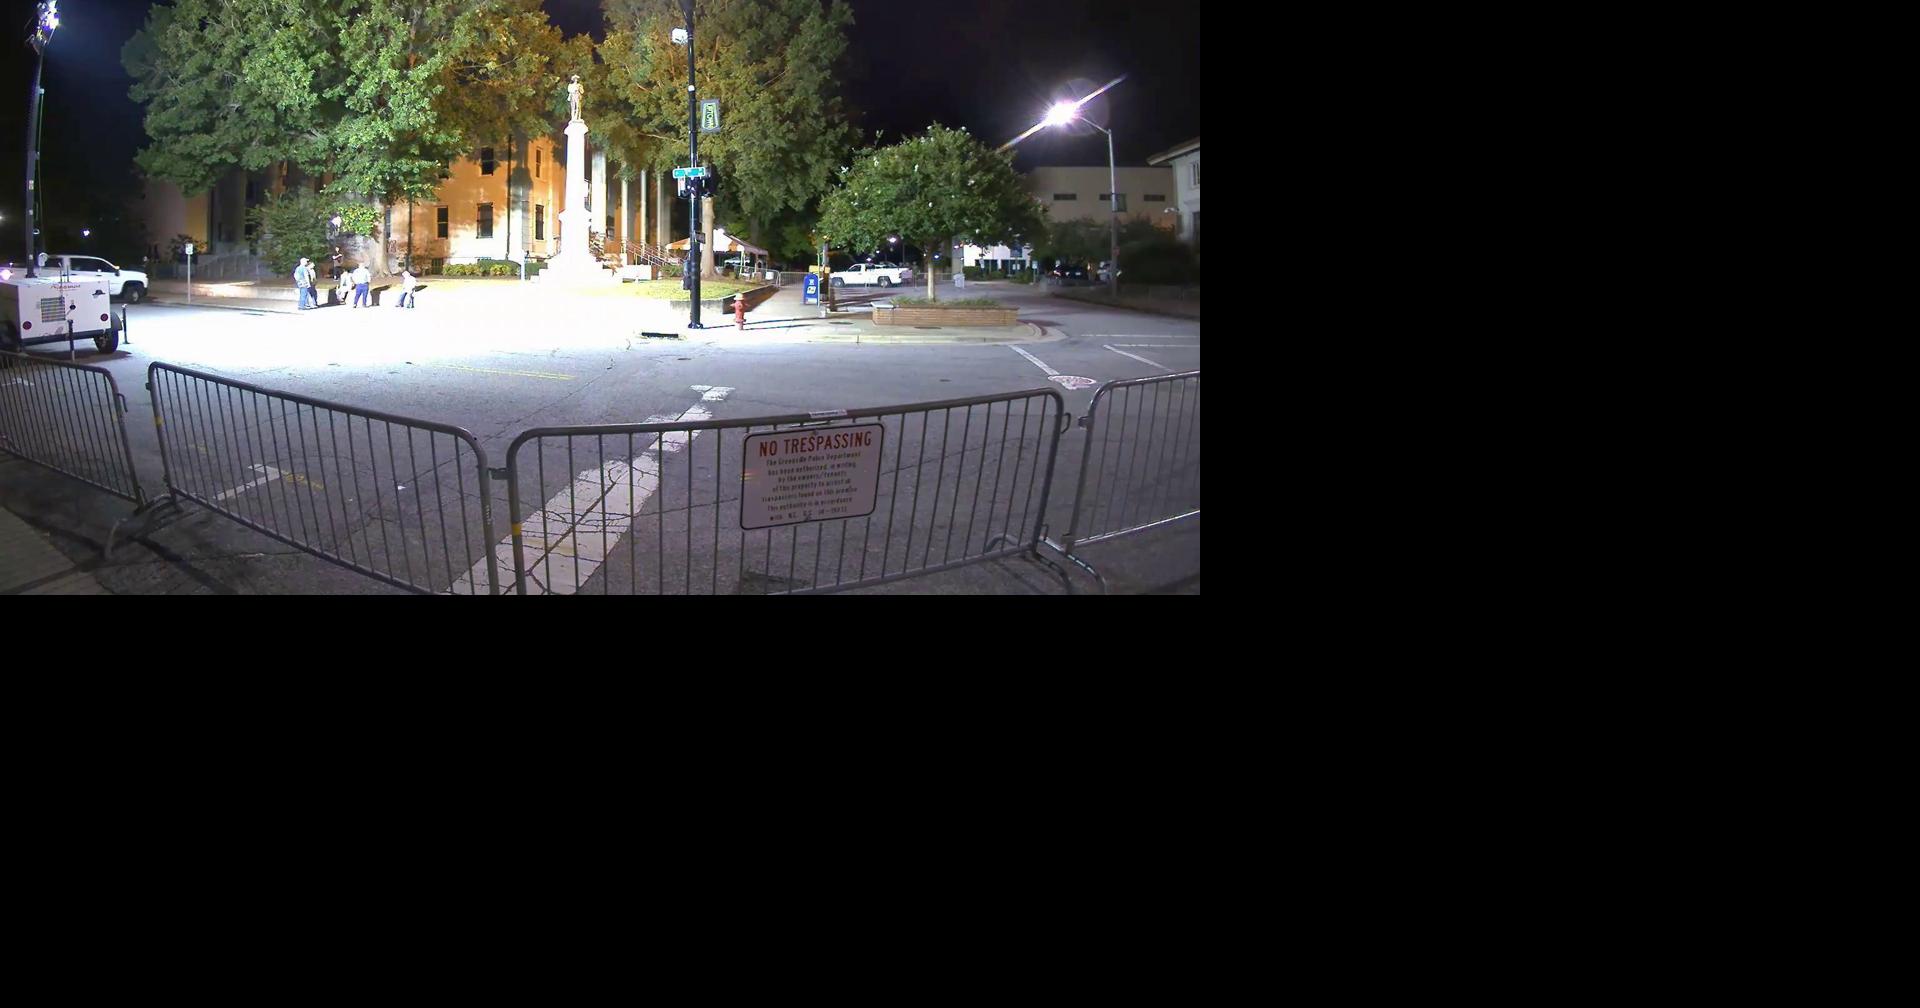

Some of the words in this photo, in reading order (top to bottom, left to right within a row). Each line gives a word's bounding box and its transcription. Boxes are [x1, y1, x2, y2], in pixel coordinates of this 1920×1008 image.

[760, 441, 777, 456] NO
[784, 431, 872, 454] TRESPASSING
[826, 452, 861, 460] Department
